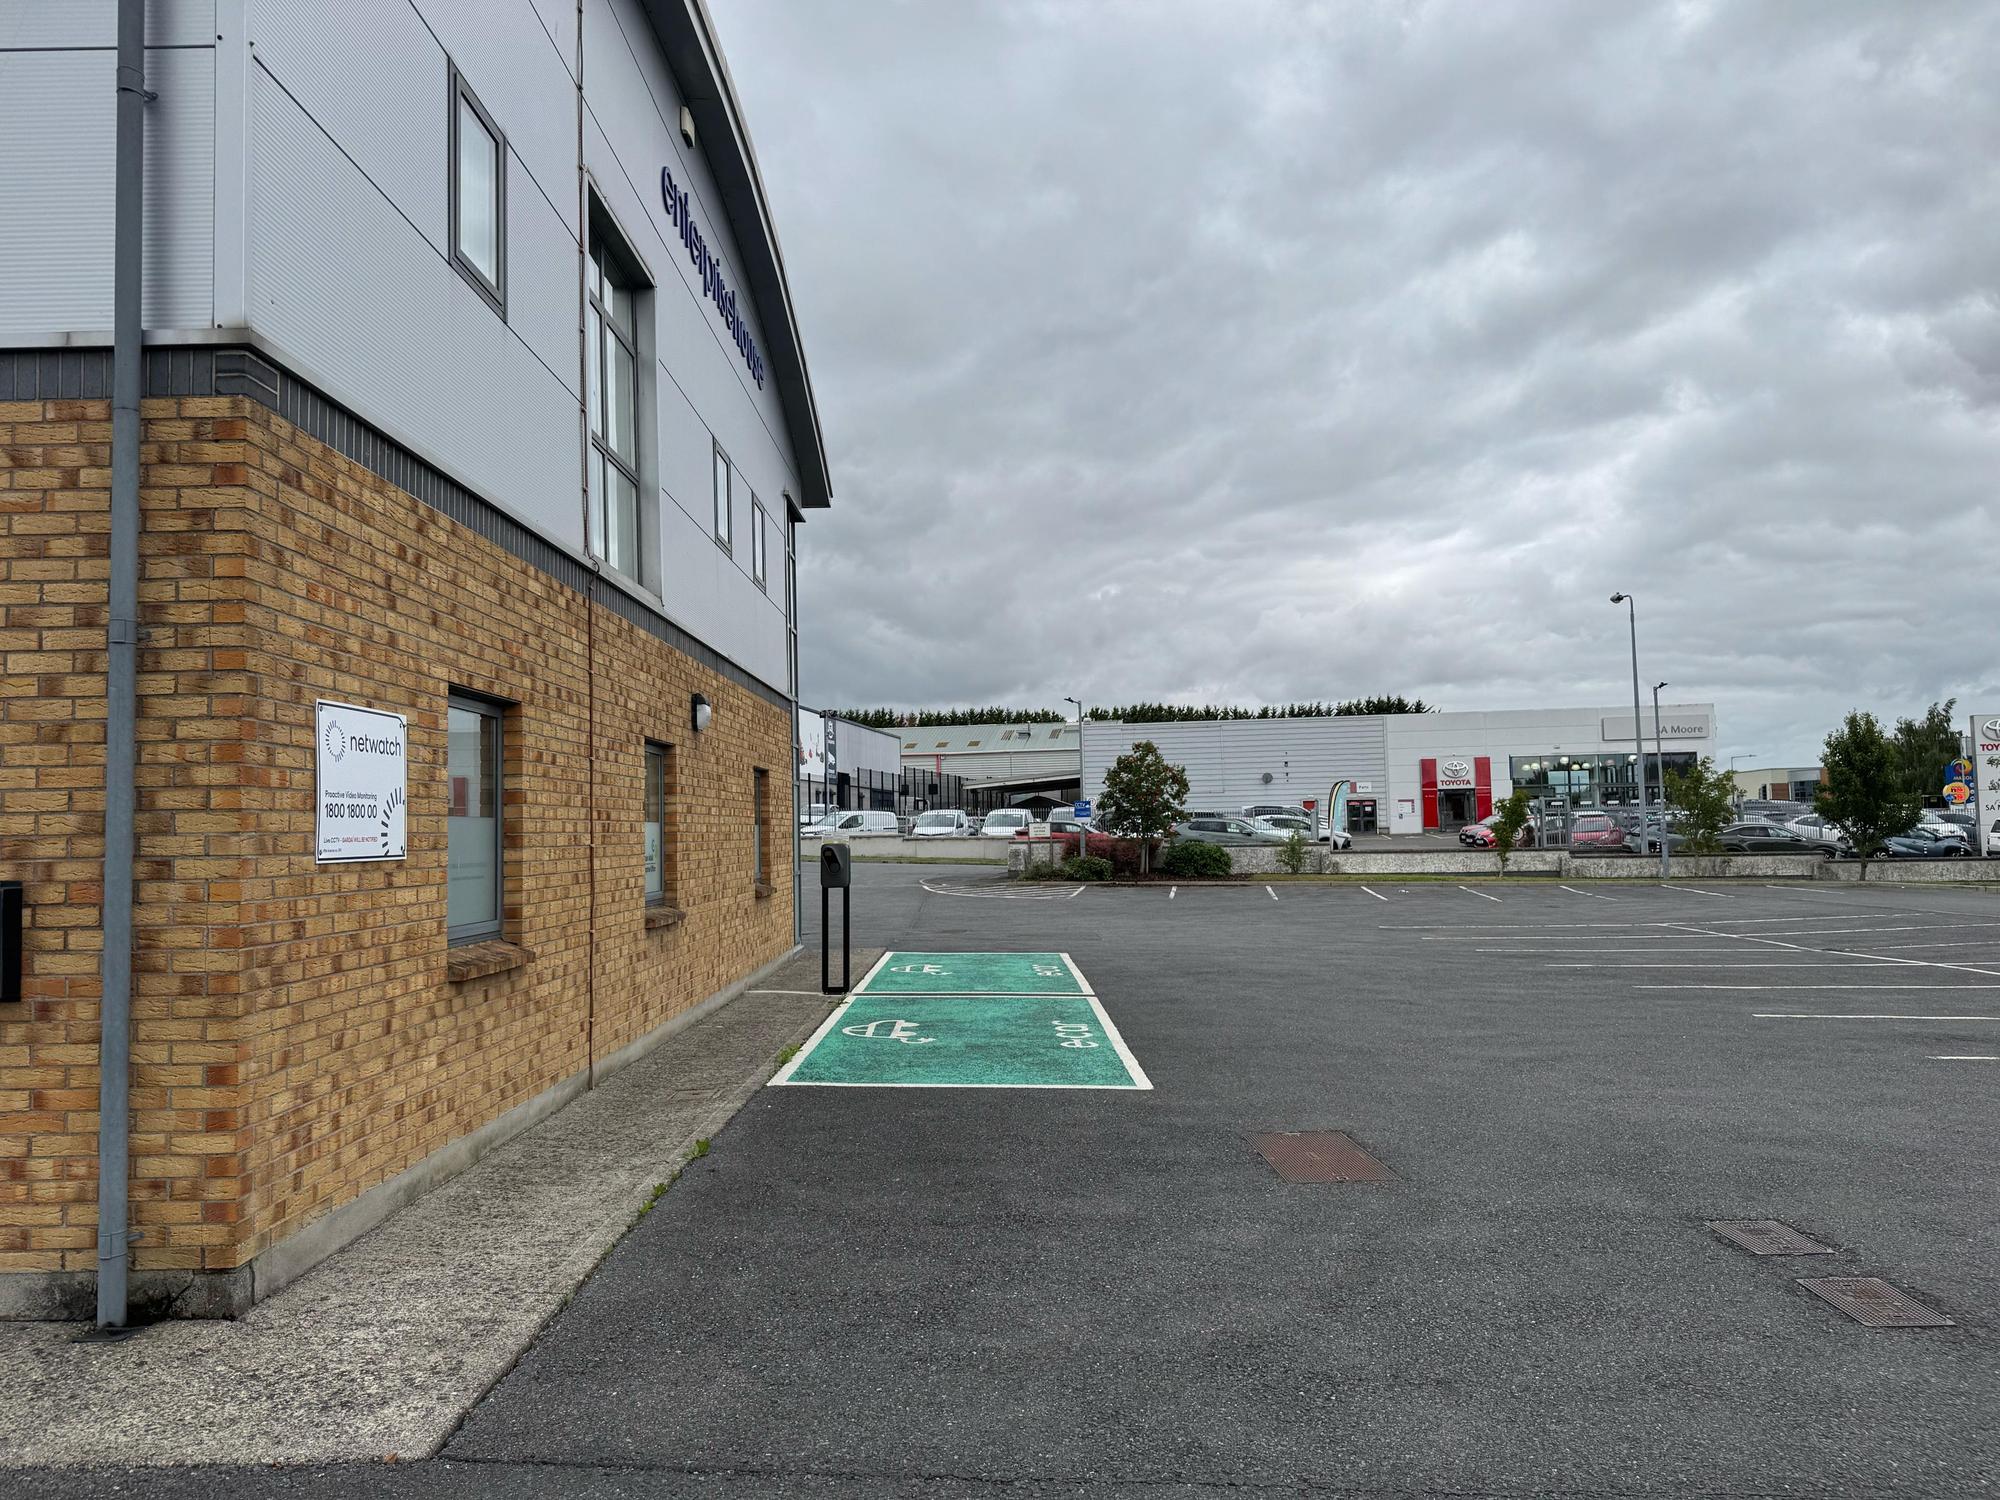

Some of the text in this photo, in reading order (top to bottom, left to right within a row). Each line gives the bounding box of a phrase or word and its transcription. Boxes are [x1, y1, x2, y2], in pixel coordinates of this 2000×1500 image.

[1671, 725, 1703, 734] Moore
[350, 733, 402, 756] netwatch
[325, 803, 378, 818] 1800 1800 00
[1051, 1020, 1099, 1048] ecar
